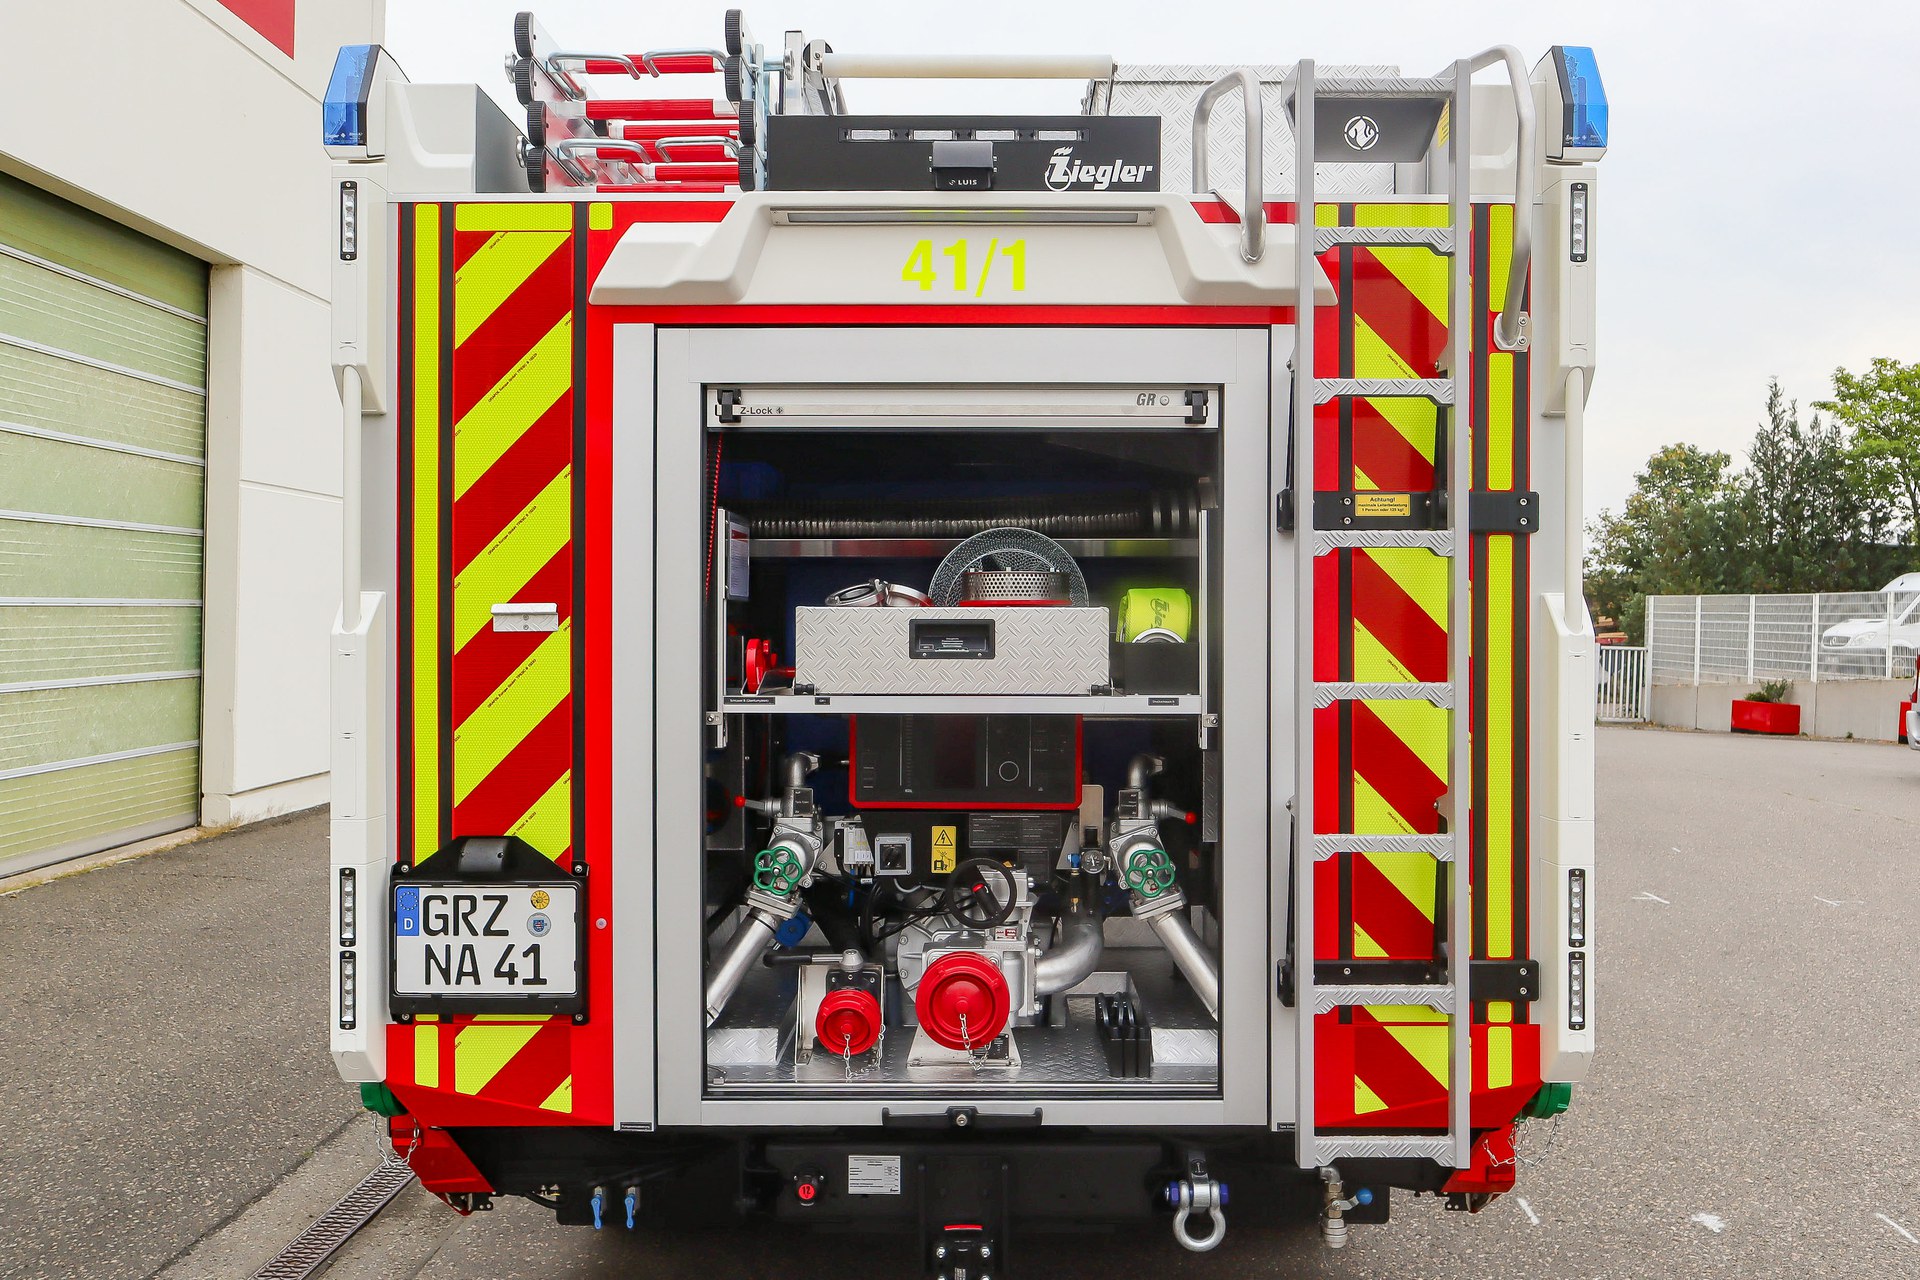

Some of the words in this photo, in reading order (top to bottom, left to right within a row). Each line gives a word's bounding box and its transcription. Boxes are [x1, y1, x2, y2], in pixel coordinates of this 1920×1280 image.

[1045, 151, 1153, 191] Ziegler
[901, 238, 1027, 298] 41/1
[740, 406, 773, 415] Z-Lock
[1136, 392, 1157, 406] GR
[403, 917, 414, 930] D
[422, 894, 509, 936] GRZ
[424, 944, 481, 985] NA
[493, 944, 548, 985] 41
[802, 1186, 811, 1195] 12
